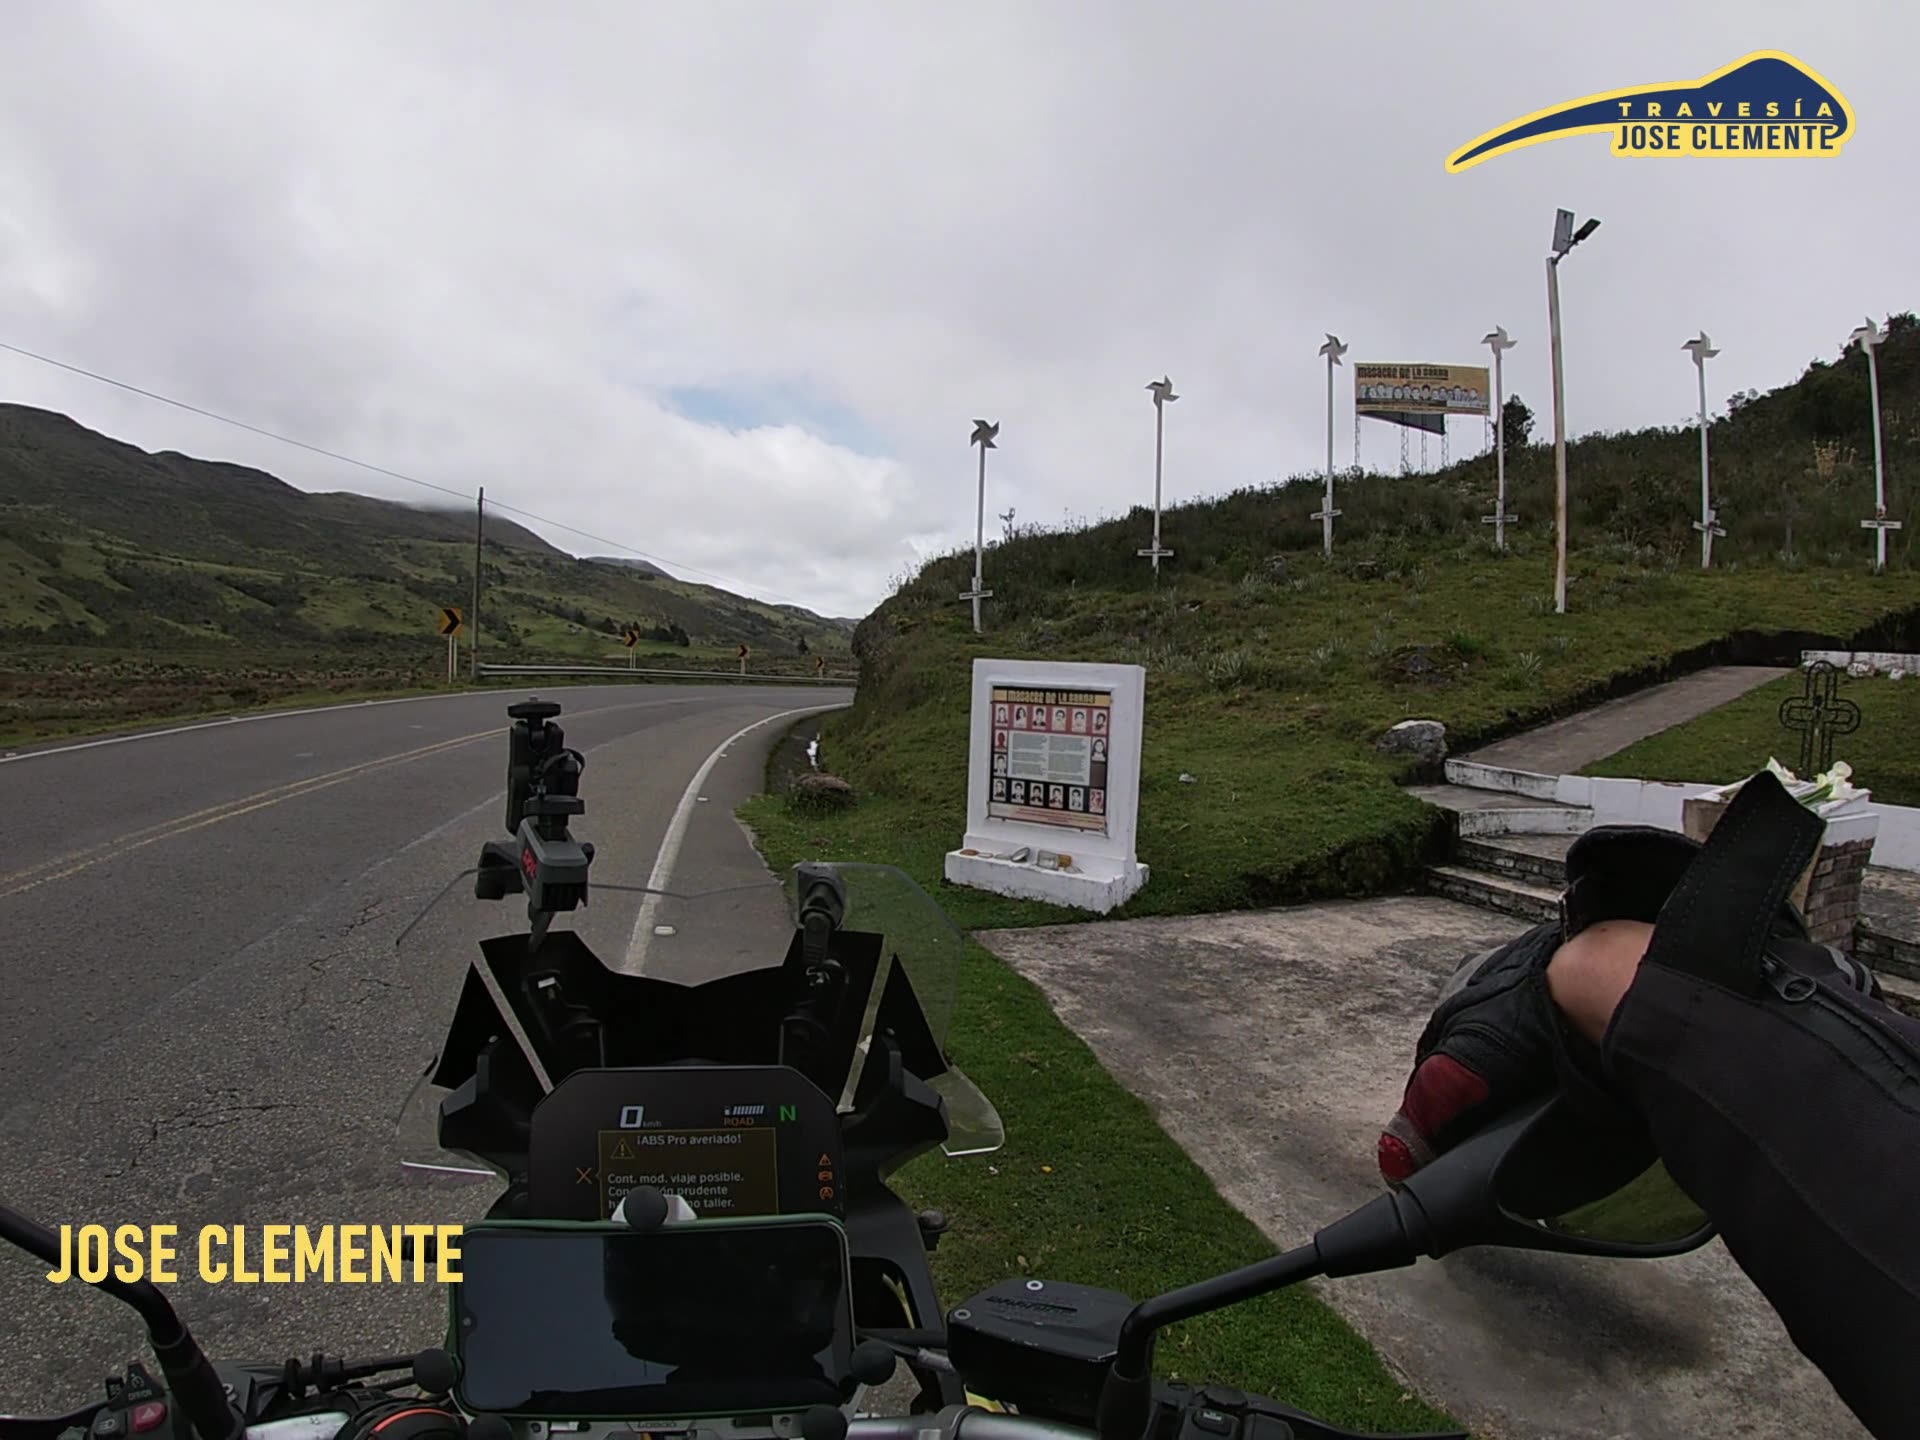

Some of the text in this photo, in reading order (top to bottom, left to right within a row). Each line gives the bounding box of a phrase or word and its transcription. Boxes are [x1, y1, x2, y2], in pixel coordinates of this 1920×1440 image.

[779, 1105, 797, 1121] N
[723, 1117, 755, 1126] ROAD
[667, 1135, 687, 1145] Pro
[689, 1133, 742, 1145] averiado!
[608, 1171, 744, 1185] Cont. mod. viaje posible.
[676, 1185, 729, 1198] prudente
[703, 1198, 735, 1209] taller.
